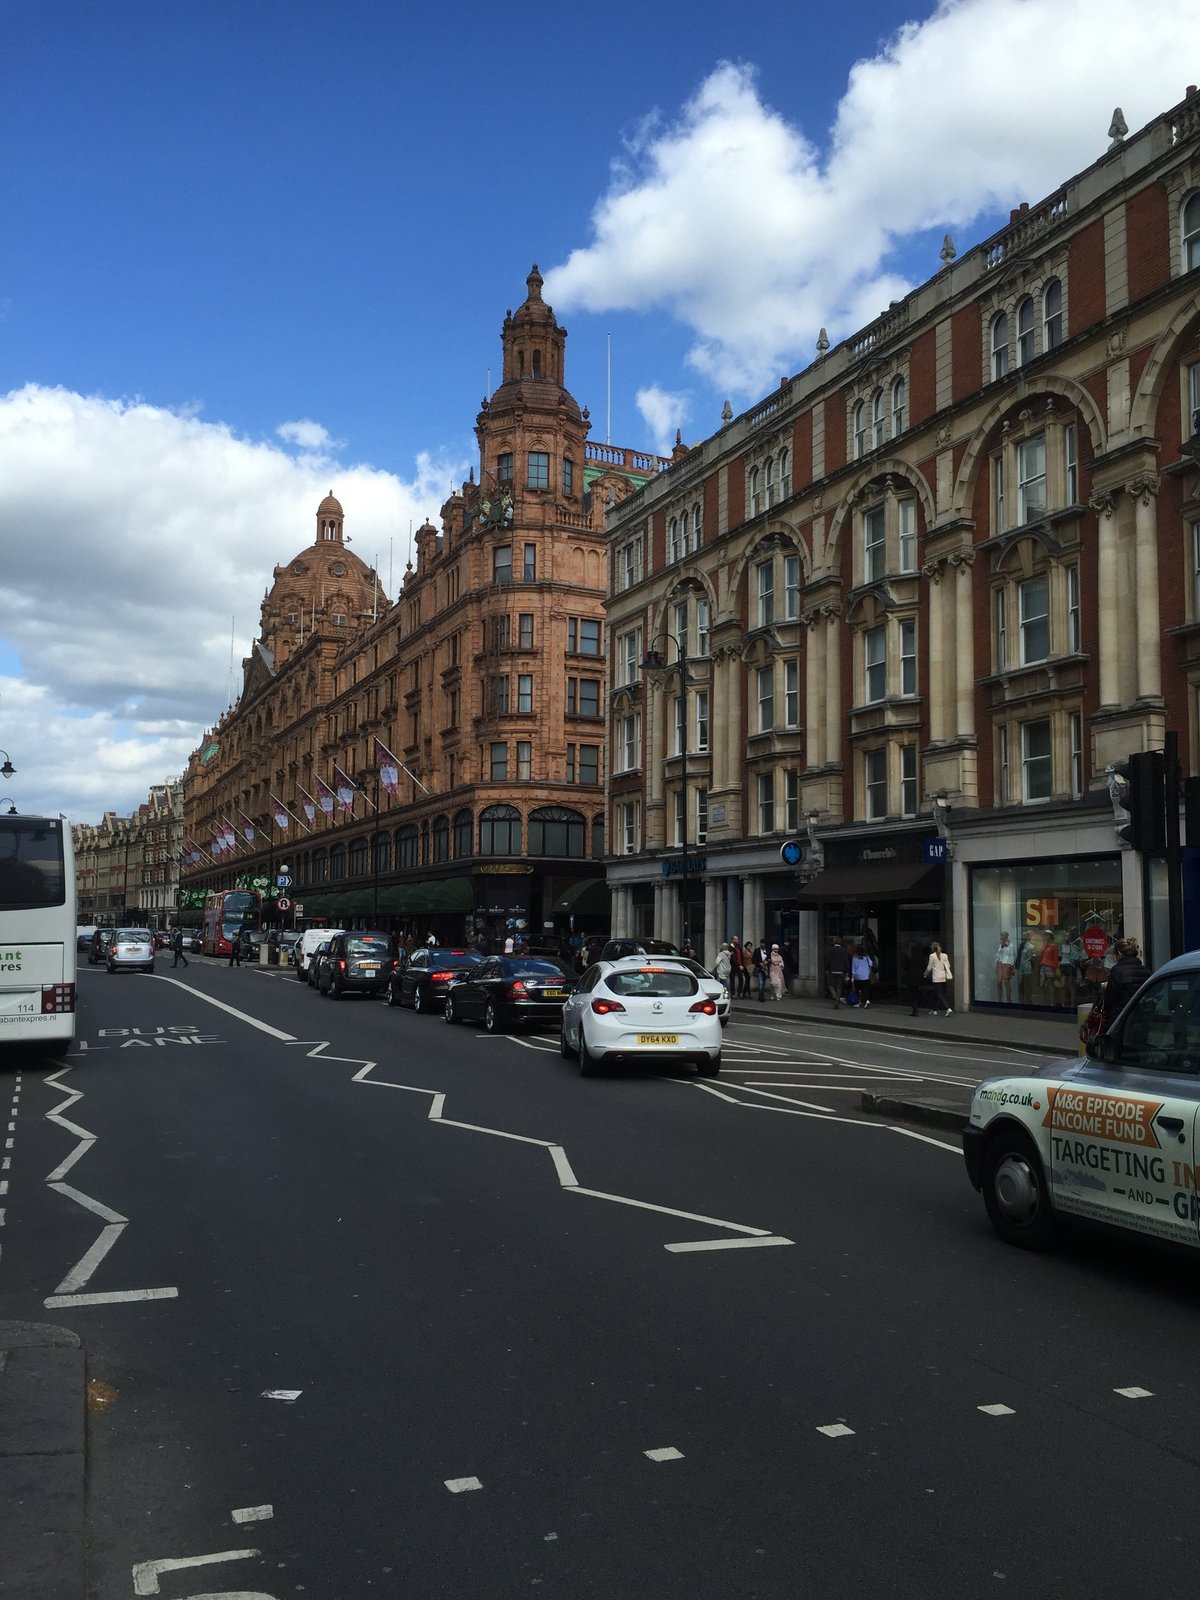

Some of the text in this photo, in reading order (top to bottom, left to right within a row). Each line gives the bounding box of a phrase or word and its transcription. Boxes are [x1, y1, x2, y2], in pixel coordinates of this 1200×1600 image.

[929, 844, 944, 857] GAP
[0, 950, 22, 961] nt
[18, 1004, 34, 1013] 114
[98, 1025, 200, 1037] BUS
[640, 1035, 677, 1043] DY64 KXO
[79, 1034, 229, 1050] LANE
[979, 1088, 1034, 1107] mandg.co.uk
[1053, 1092, 1145, 1122] M&G EPISODE
[1051, 1109, 1146, 1142] INCOME FUND
[1052, 1136, 1166, 1184] TARGETING
[1128, 1188, 1154, 1206] AND
